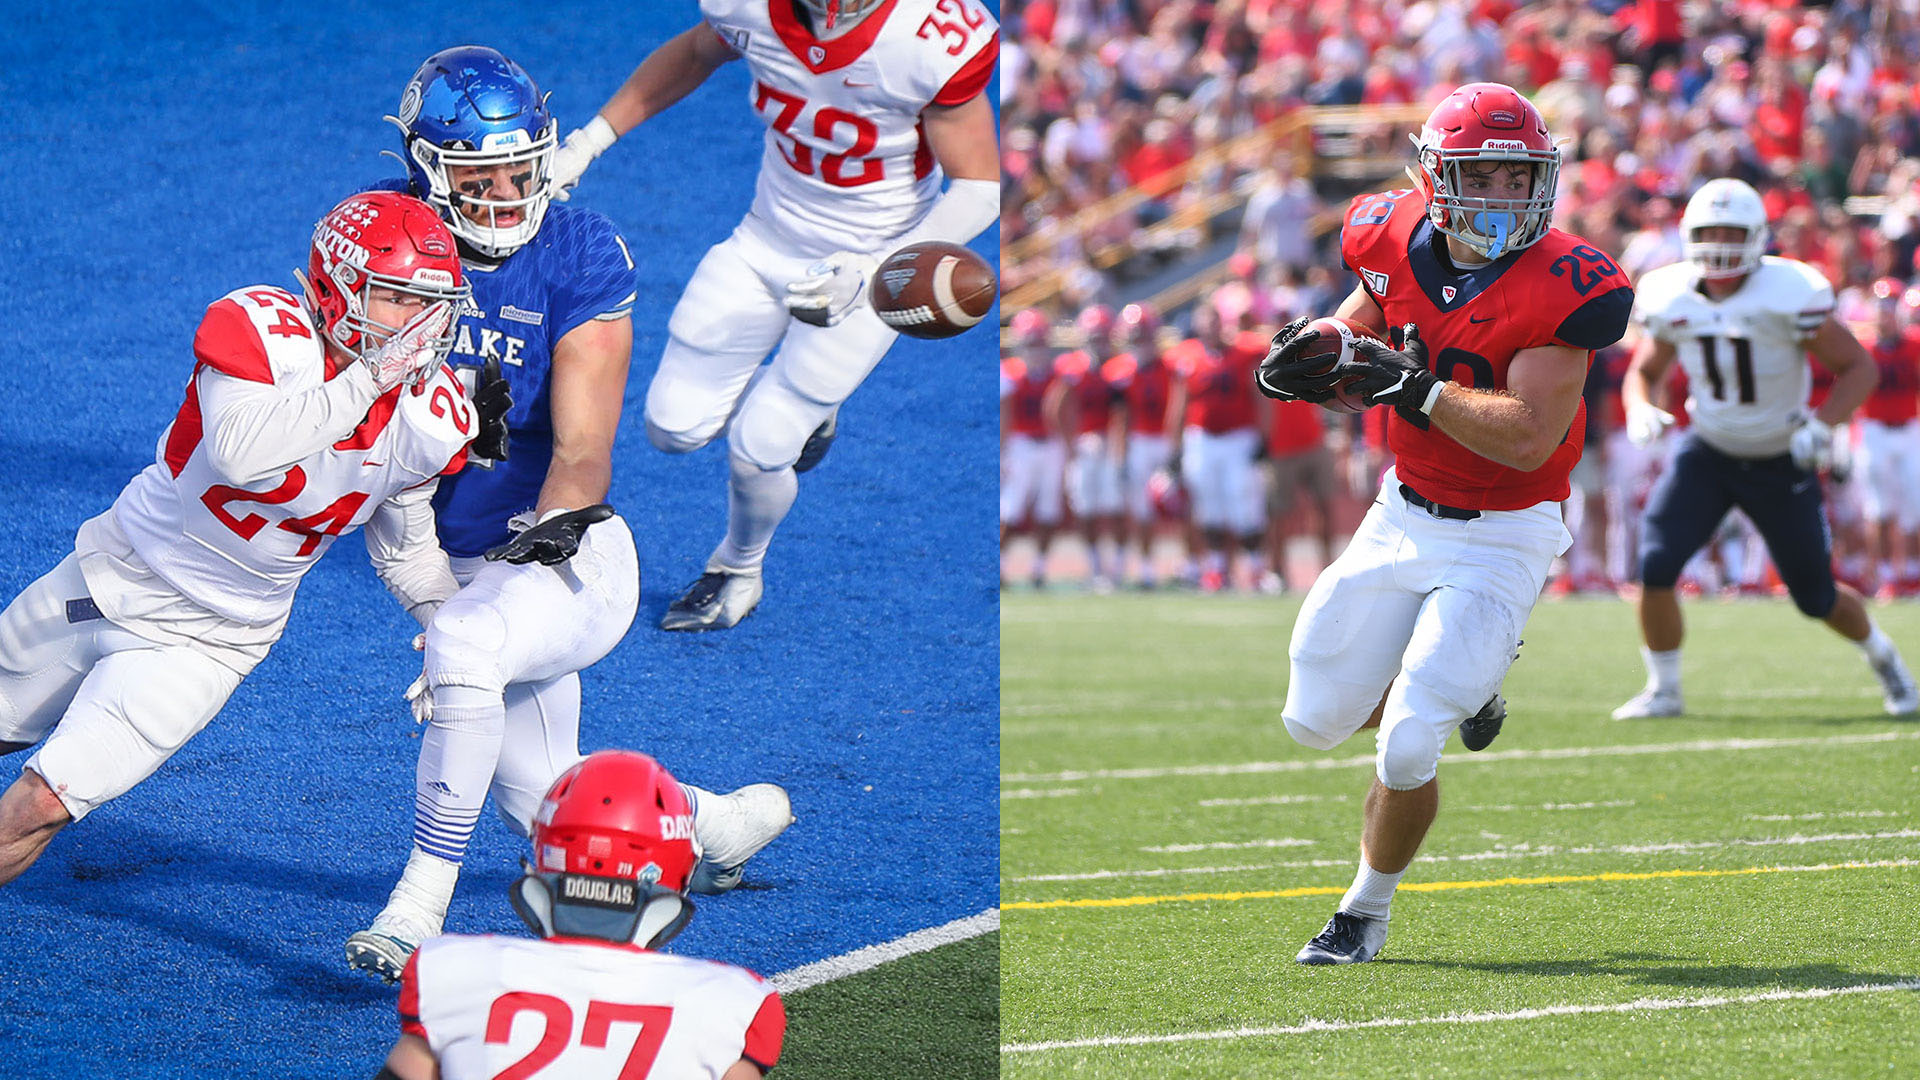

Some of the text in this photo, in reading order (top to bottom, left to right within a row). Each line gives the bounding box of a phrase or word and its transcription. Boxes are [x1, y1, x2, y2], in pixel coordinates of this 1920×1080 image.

[916, 0, 987, 57] 32
[754, 80, 887, 188] 32
[1487, 141, 1524, 150] Riddell
[312, 224, 371, 268] AYTON
[1549, 244, 1618, 297] 29
[244, 289, 312, 340] 24
[453, 324, 526, 367] AKE
[1697, 335, 1756, 405] 11
[199, 463, 371, 557] 24
[484, 991, 674, 1080] 27
